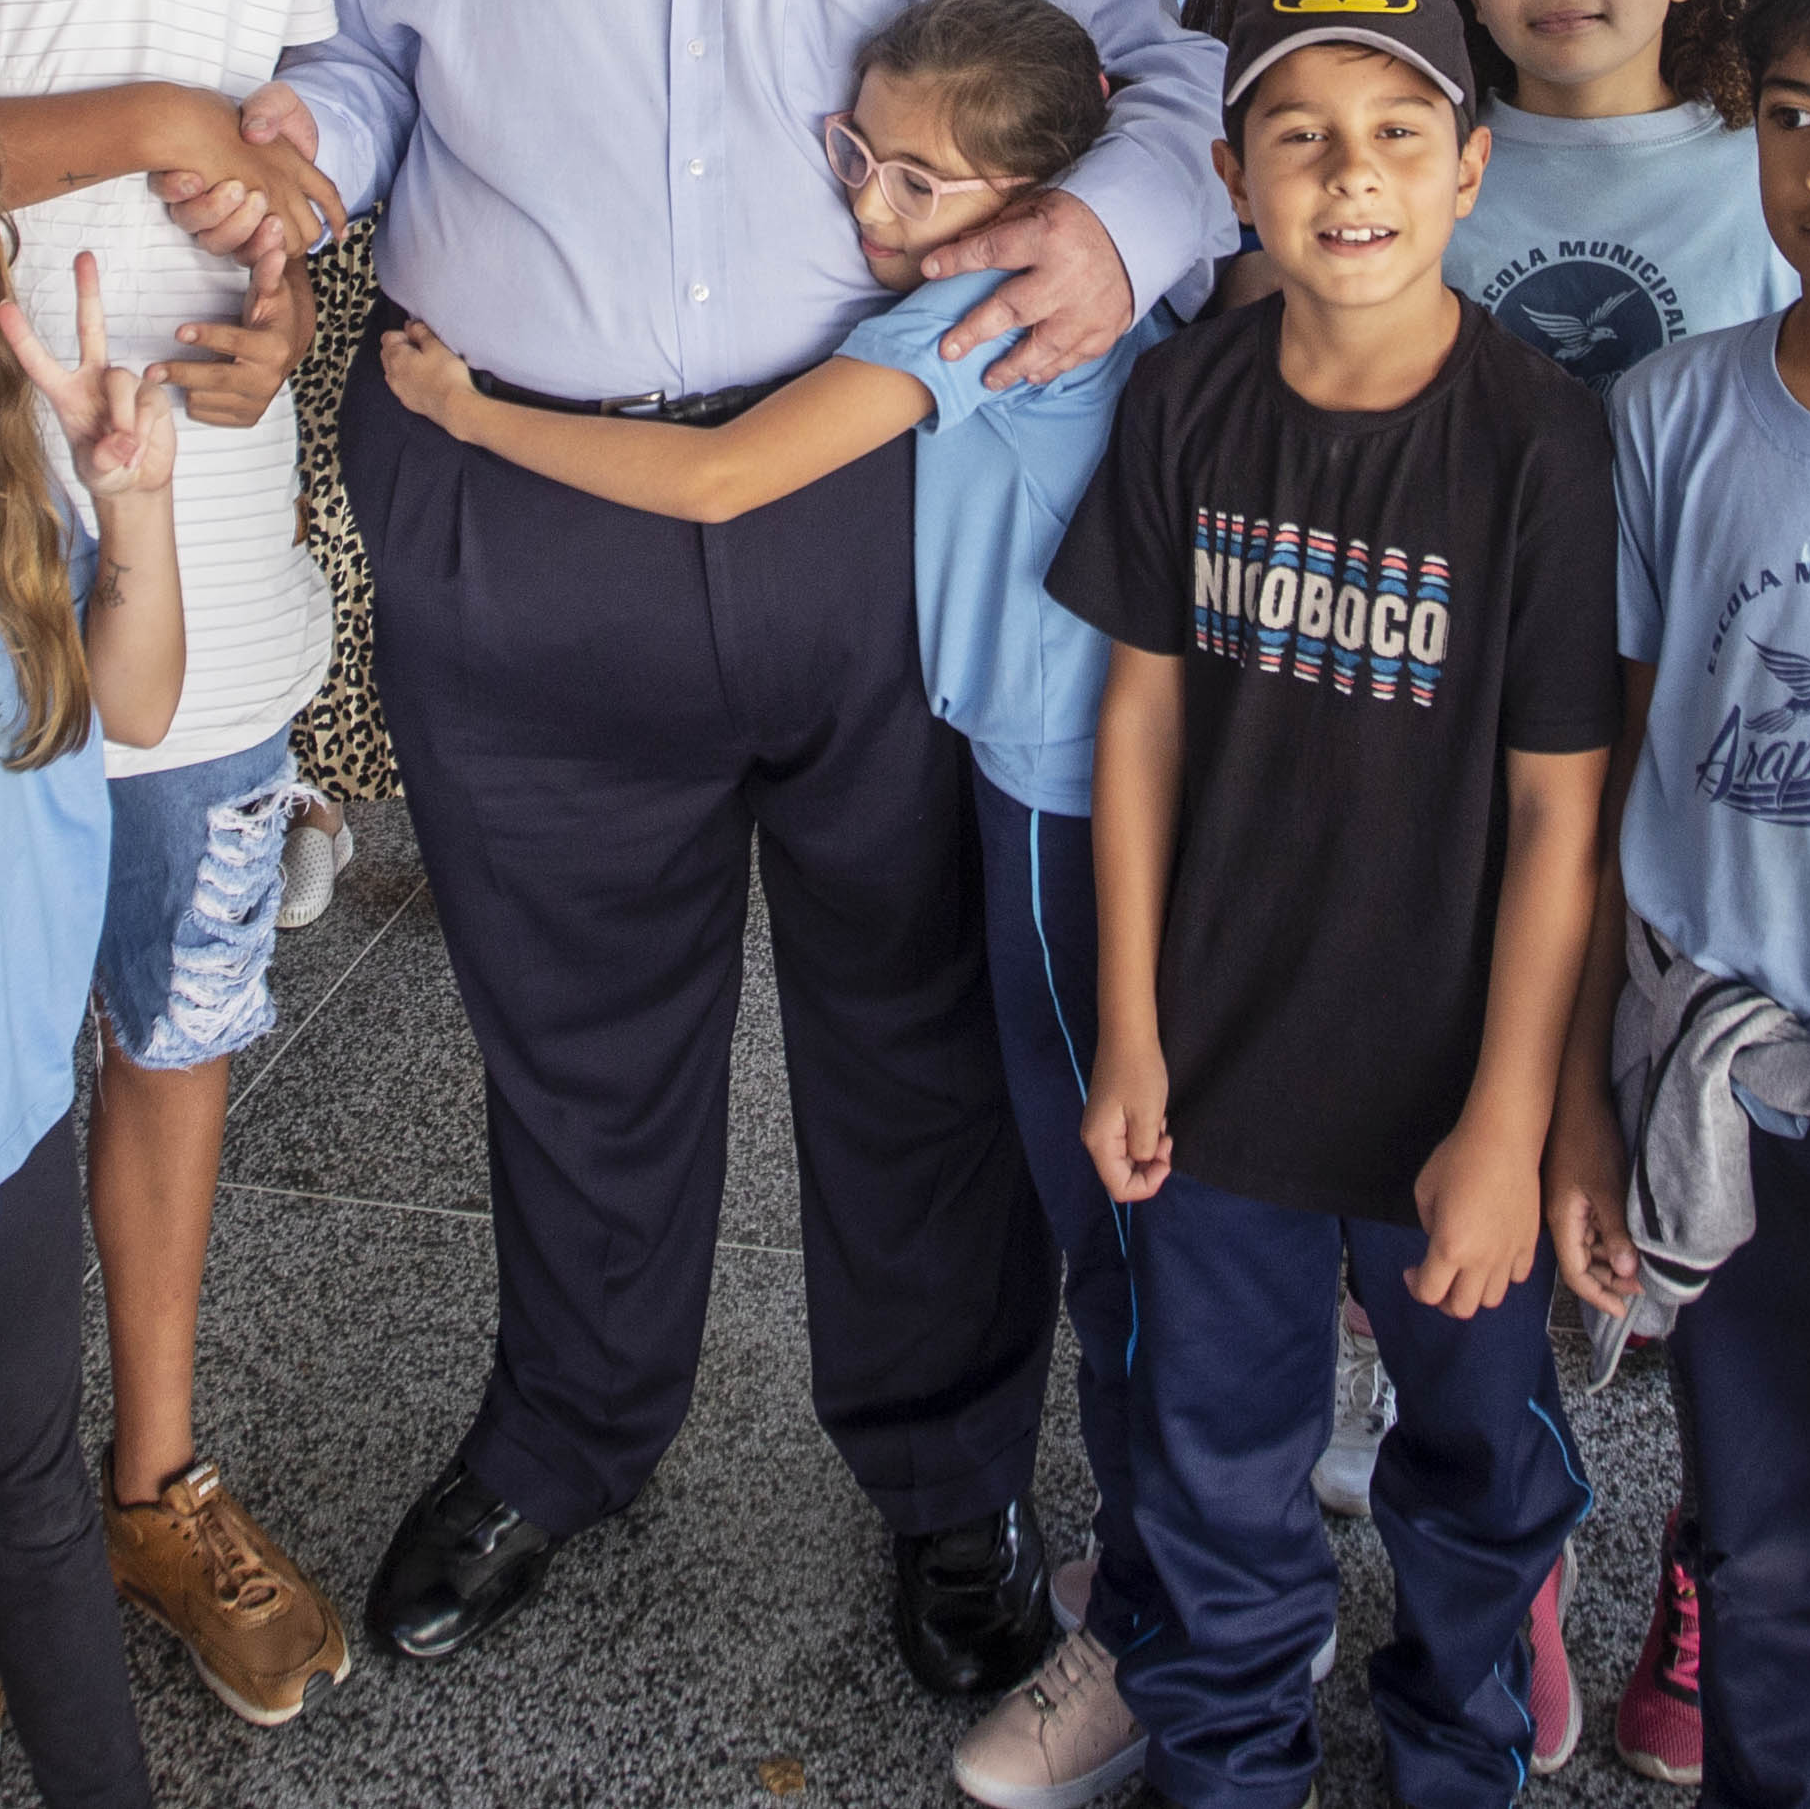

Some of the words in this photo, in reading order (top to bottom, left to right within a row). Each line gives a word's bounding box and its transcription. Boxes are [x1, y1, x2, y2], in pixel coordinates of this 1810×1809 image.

[1482, 247, 1548, 309] COLA
[1558, 240, 1687, 343] MUNICIPAL
[1707, 568, 1783, 676] ESCOLA
